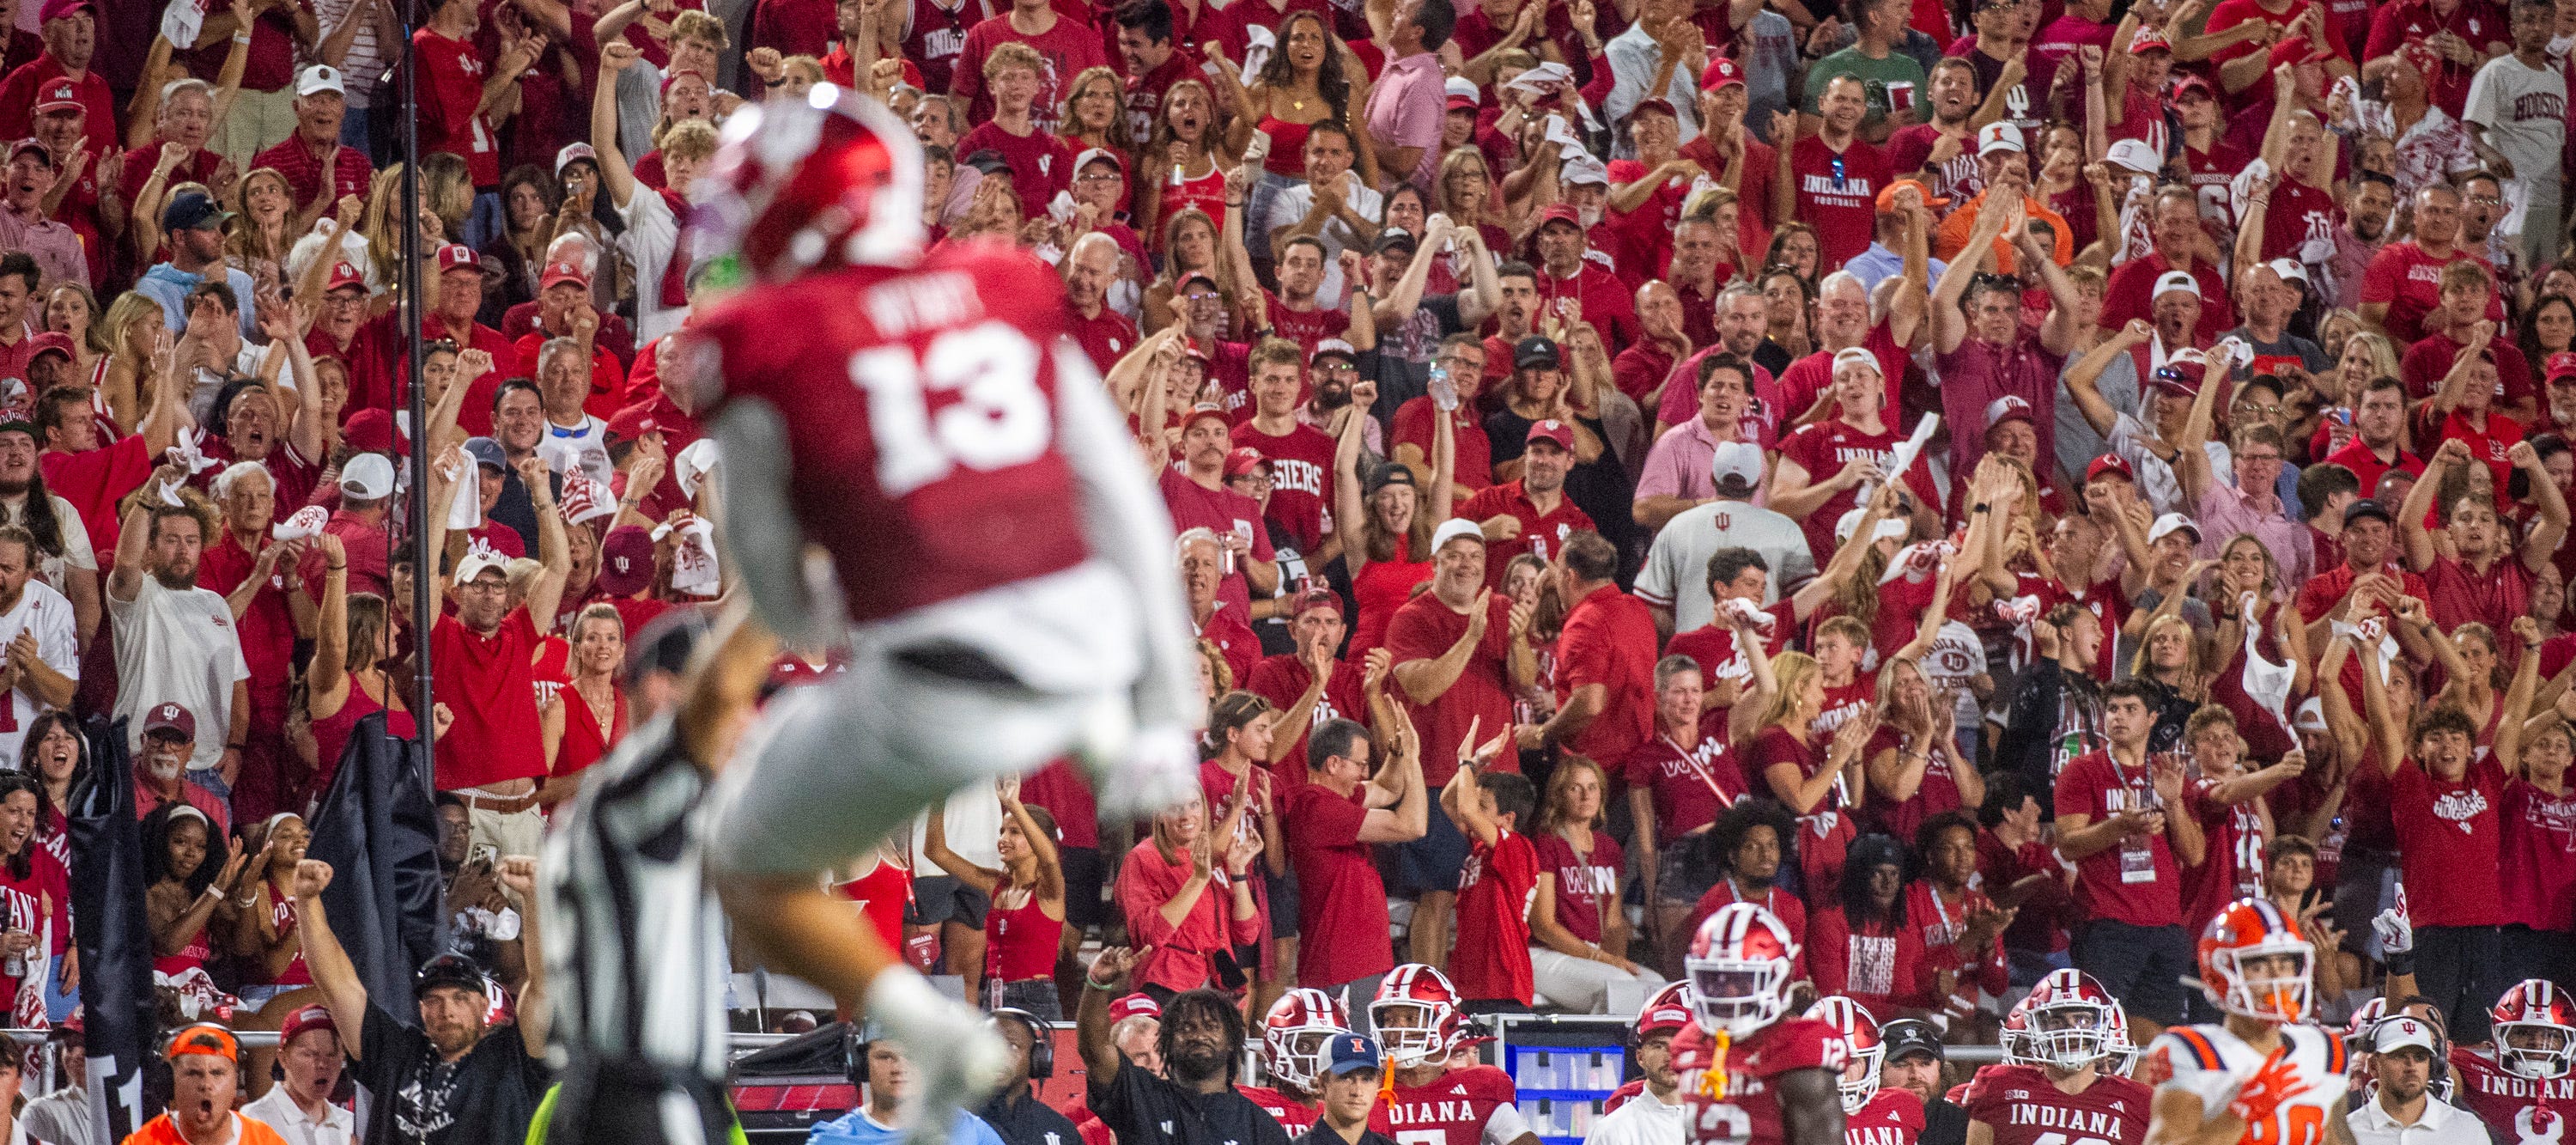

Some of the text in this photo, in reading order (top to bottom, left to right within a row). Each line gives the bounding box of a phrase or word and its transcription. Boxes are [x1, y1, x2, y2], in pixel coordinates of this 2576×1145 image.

[1813, 195, 1862, 208] FOOTBALL
[848, 320, 1054, 496] 13
[2009, 1102, 2123, 1141] INDIANA
